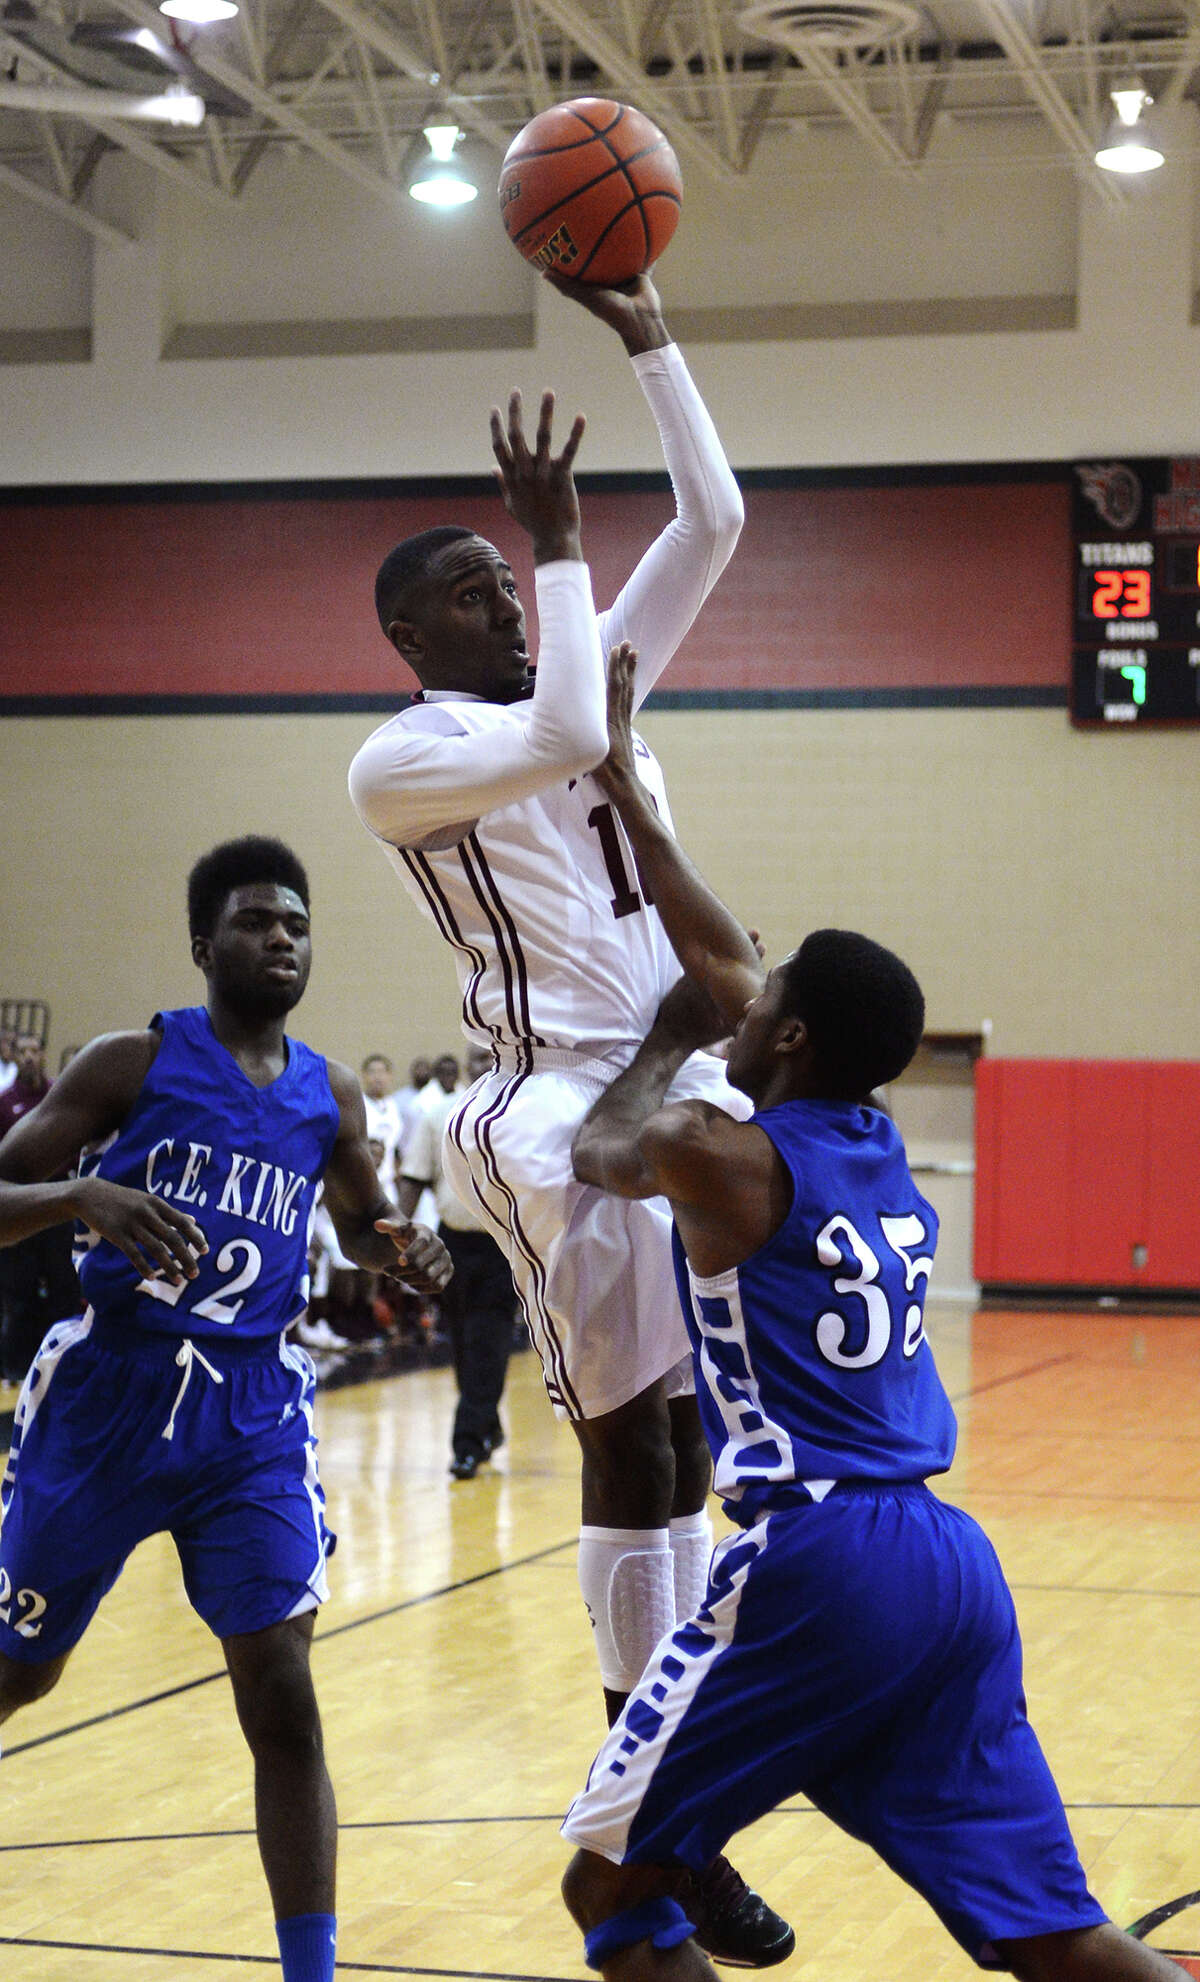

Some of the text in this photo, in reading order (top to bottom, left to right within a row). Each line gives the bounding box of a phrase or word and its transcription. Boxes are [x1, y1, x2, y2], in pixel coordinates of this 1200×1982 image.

[1081, 542, 1154, 566] TITANS
[1093, 570, 1151, 619] 23
[1120, 665, 1146, 705] 7
[146, 1137, 307, 1236] C.E. KING
[815, 1214, 934, 1369] 35
